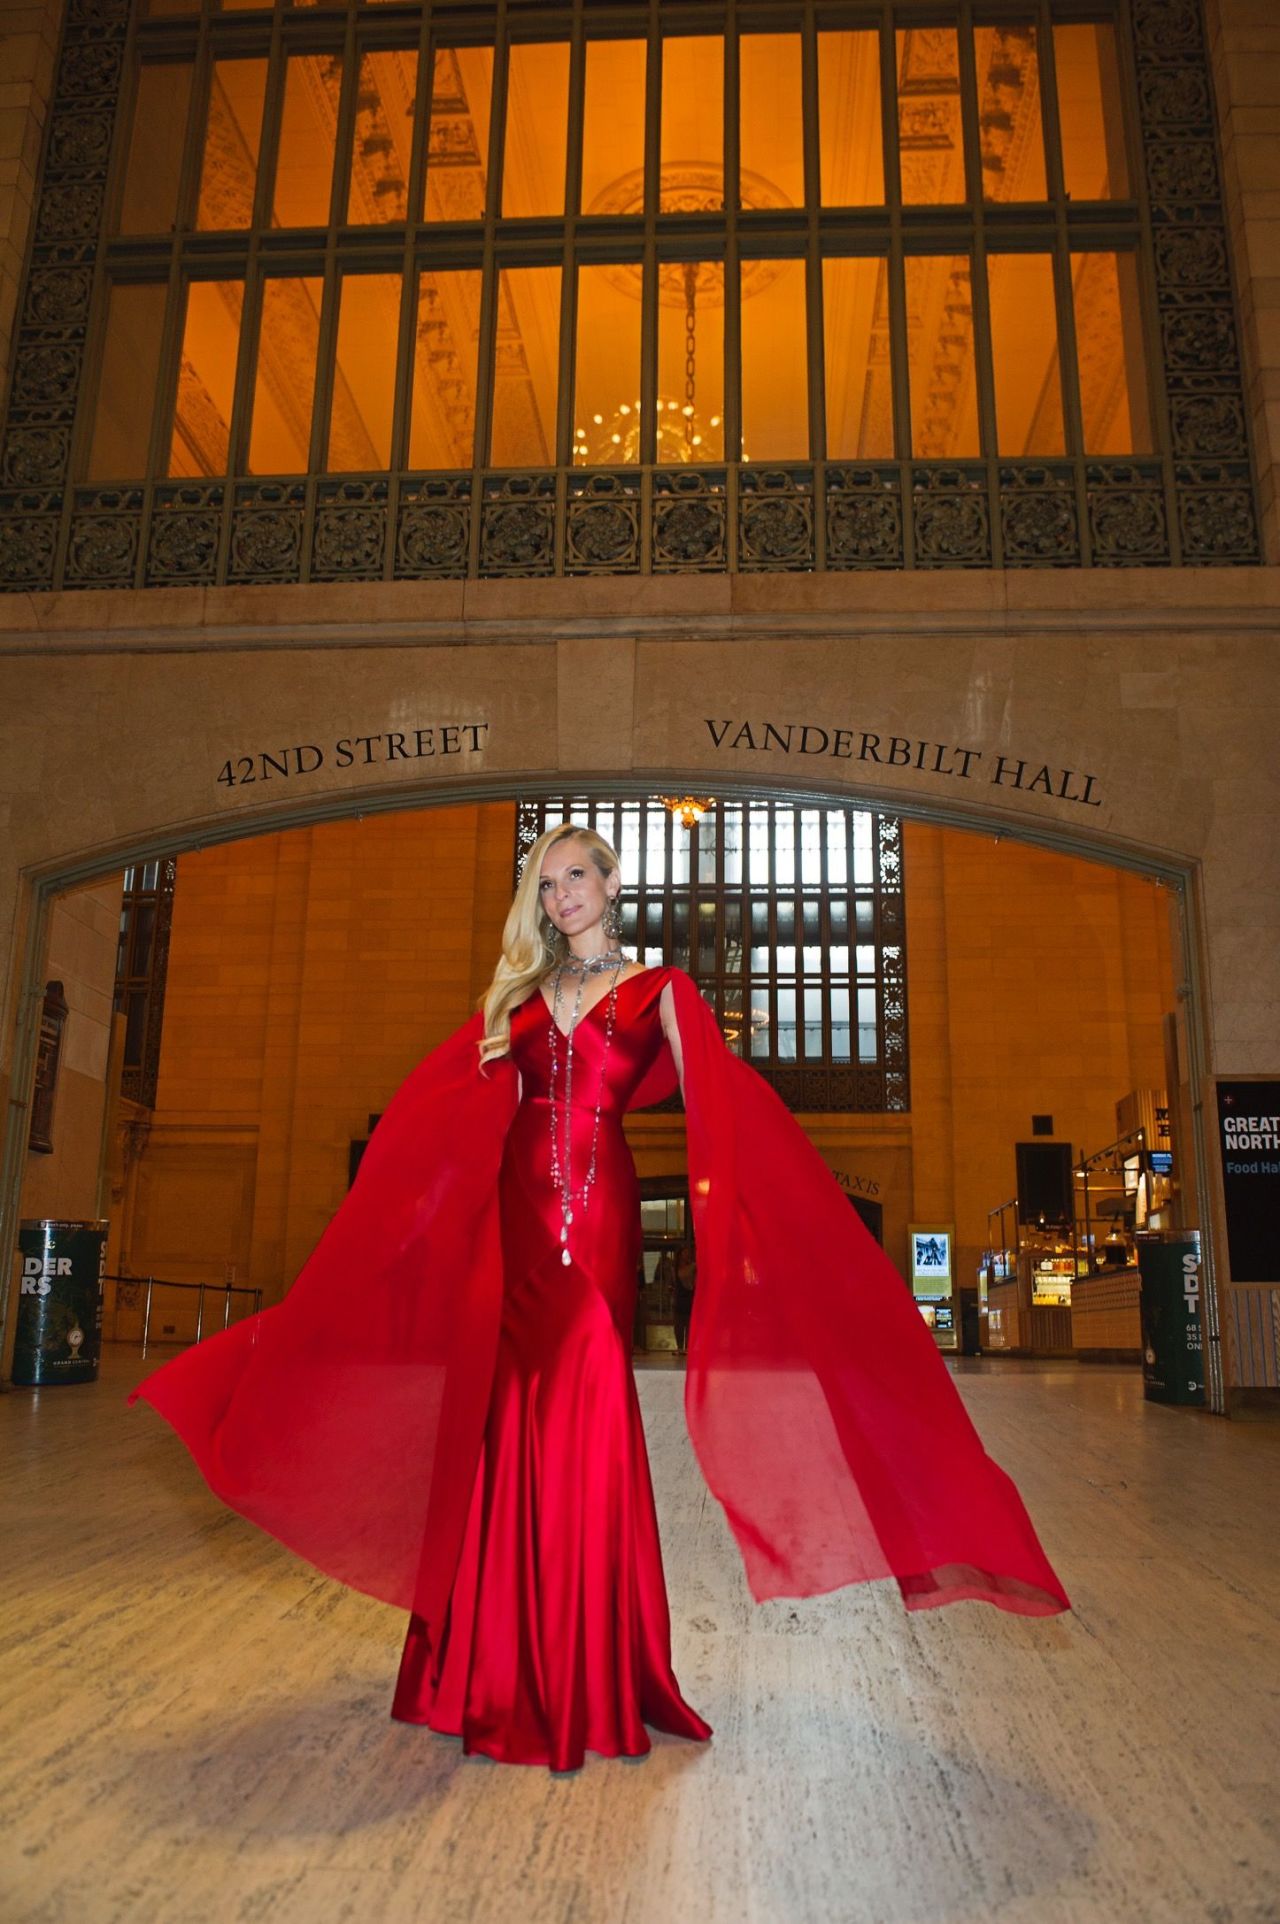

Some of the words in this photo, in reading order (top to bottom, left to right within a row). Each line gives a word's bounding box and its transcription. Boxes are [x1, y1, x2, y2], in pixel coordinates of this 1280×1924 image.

[216, 744, 324, 788] 42ND
[335, 722, 489, 769] STREET
[703, 719, 983, 778] VANDERBILT
[989, 756, 1102, 806] HALL
[1223, 1116, 1280, 1133] GREAT
[1226, 1161, 1258, 1174] Food
[24, 1257, 73, 1276] DER
[1186, 1343, 1203, 1351] ON
